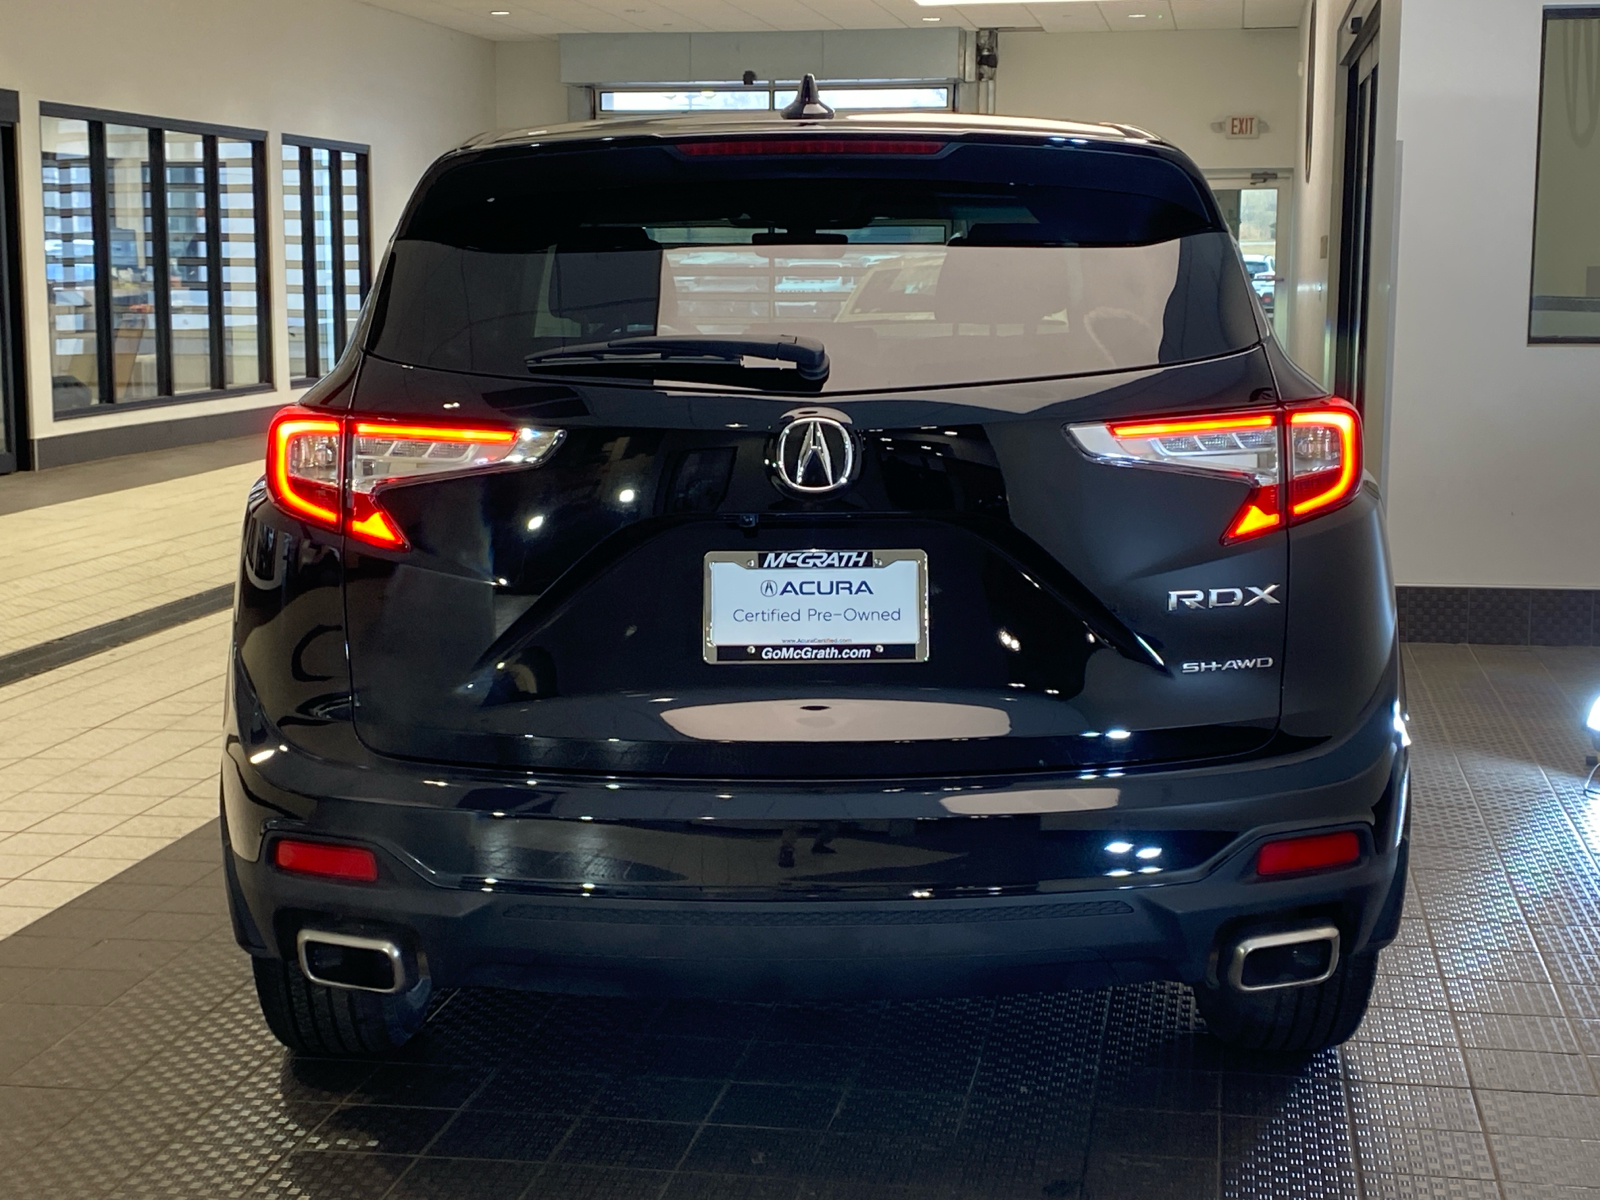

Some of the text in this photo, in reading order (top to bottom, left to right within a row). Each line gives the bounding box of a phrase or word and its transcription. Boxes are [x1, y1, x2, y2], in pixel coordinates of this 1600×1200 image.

[1231, 117, 1255, 135] EXIT
[779, 580, 874, 596] ACURA
[1168, 584, 1280, 611] RDX
[732, 607, 901, 622] Certified Pre-Owned
[761, 646, 871, 660] GoMcGrath.com
